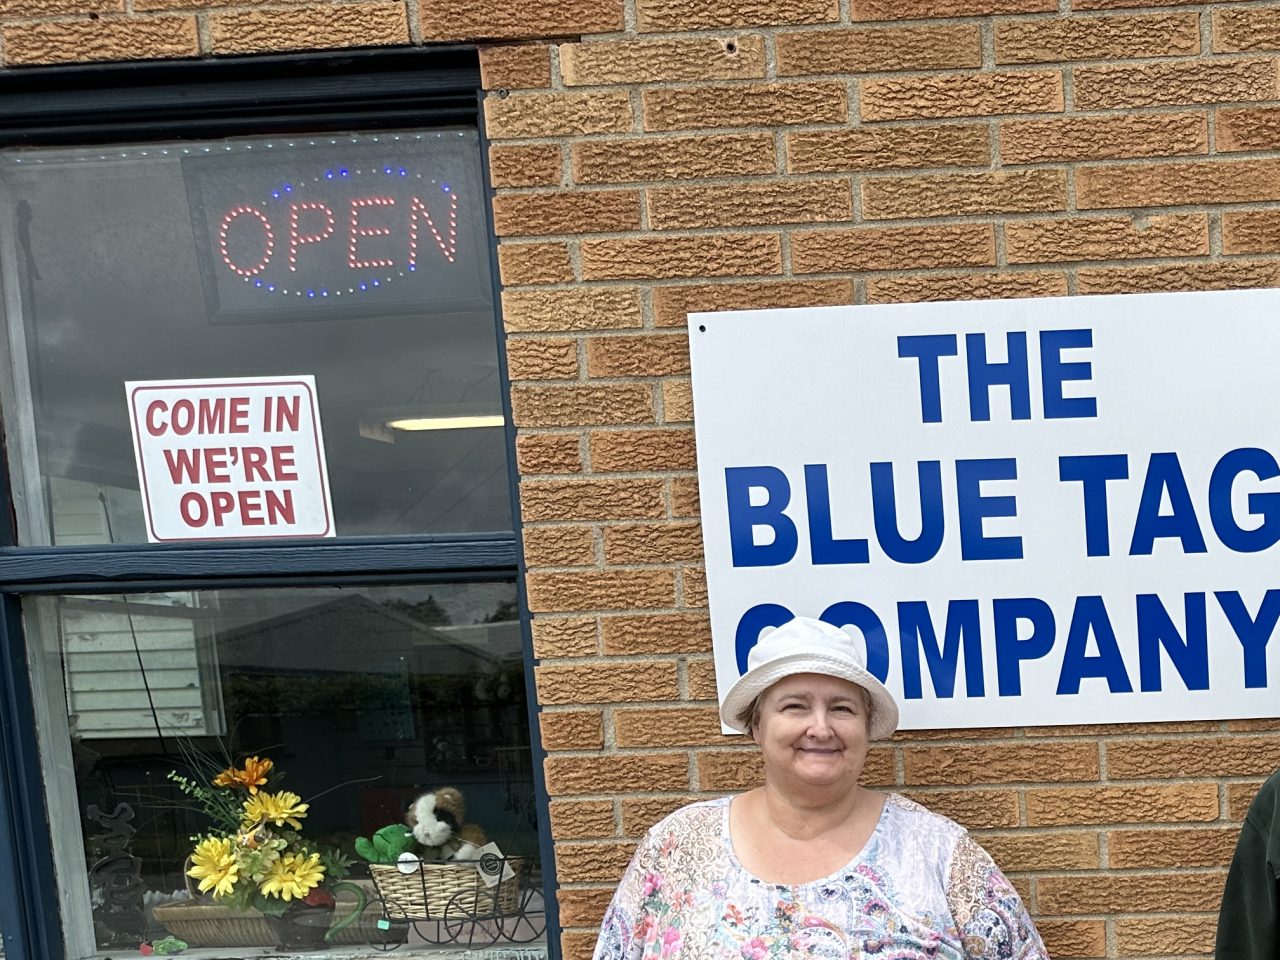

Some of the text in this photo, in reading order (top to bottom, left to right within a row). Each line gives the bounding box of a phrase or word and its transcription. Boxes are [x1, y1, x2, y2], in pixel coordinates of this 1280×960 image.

[218, 193, 459, 278] OPEN
[897, 328, 1097, 424] THE
[145, 396, 300, 437] COME IN
[164, 445, 298, 484] WE'RE
[180, 490, 296, 527] OPEN
[724, 457, 1024, 568] BLUE
